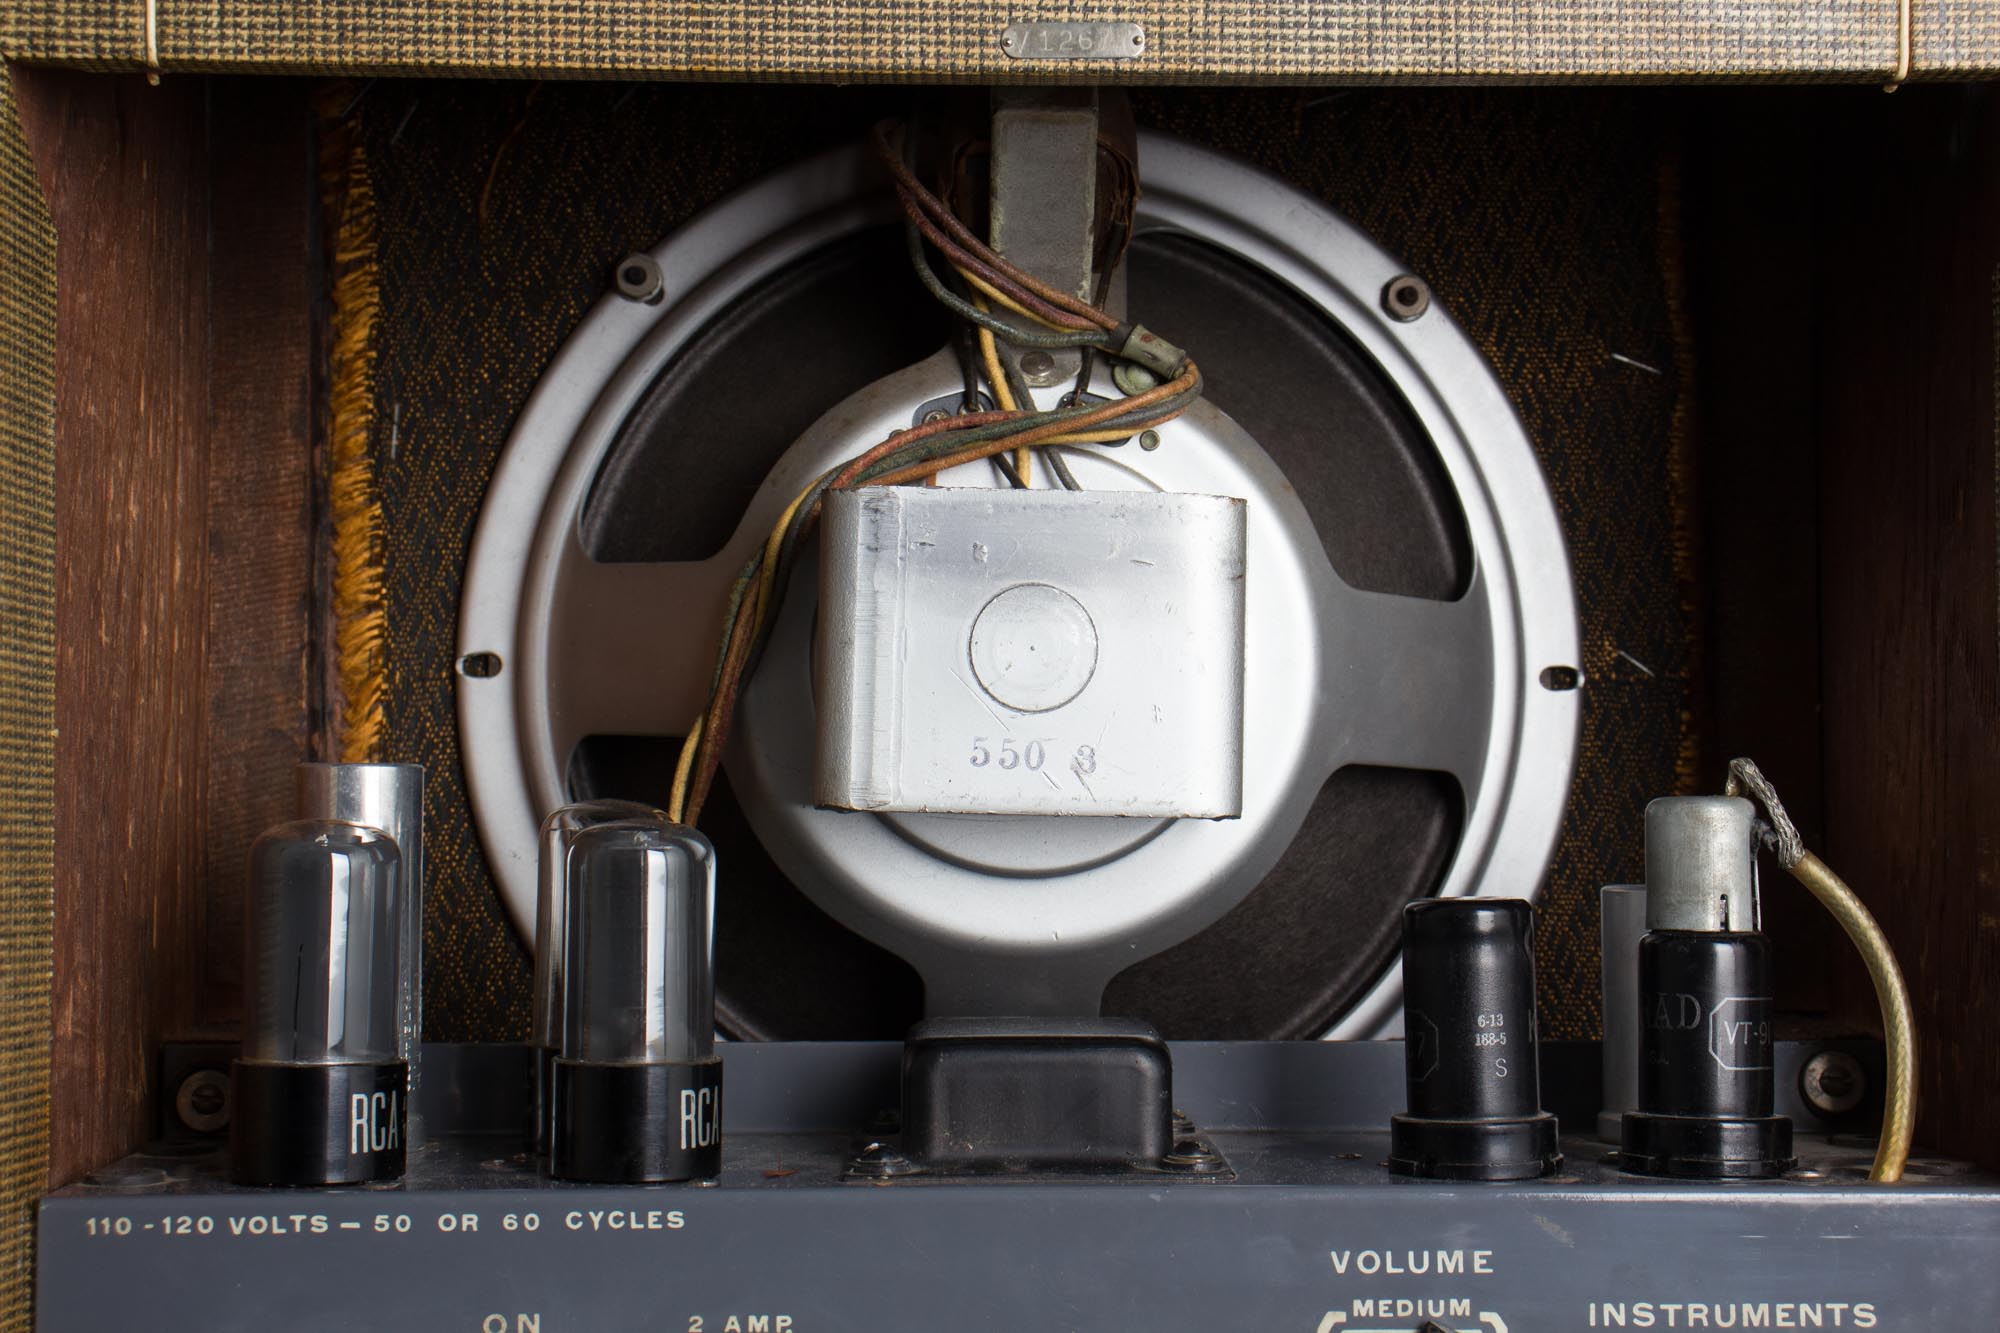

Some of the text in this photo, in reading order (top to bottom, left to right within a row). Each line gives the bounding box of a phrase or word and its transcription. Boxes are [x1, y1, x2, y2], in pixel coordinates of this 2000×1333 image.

[969, 737, 1046, 771] 550
[1477, 1014, 1504, 1028] 6-13
[1495, 1058, 1508, 1077] S
[352, 1090, 398, 1154] RCA
[680, 1086, 719, 1150] RCA
[229, 1215, 329, 1235] VOLTS
[374, 1214, 412, 1232] 50
[438, 1214, 479, 1232] OR
[503, 1213, 540, 1231] 60
[565, 1211, 686, 1231] CYCLES
[1330, 1250, 1494, 1274] VOLUME
[1352, 1299, 1471, 1318] MEDIUM
[1588, 1303, 1878, 1328] INSTRUMENTS
[483, 1314, 541, 1333] ON
[688, 1316, 704, 1333] 2
